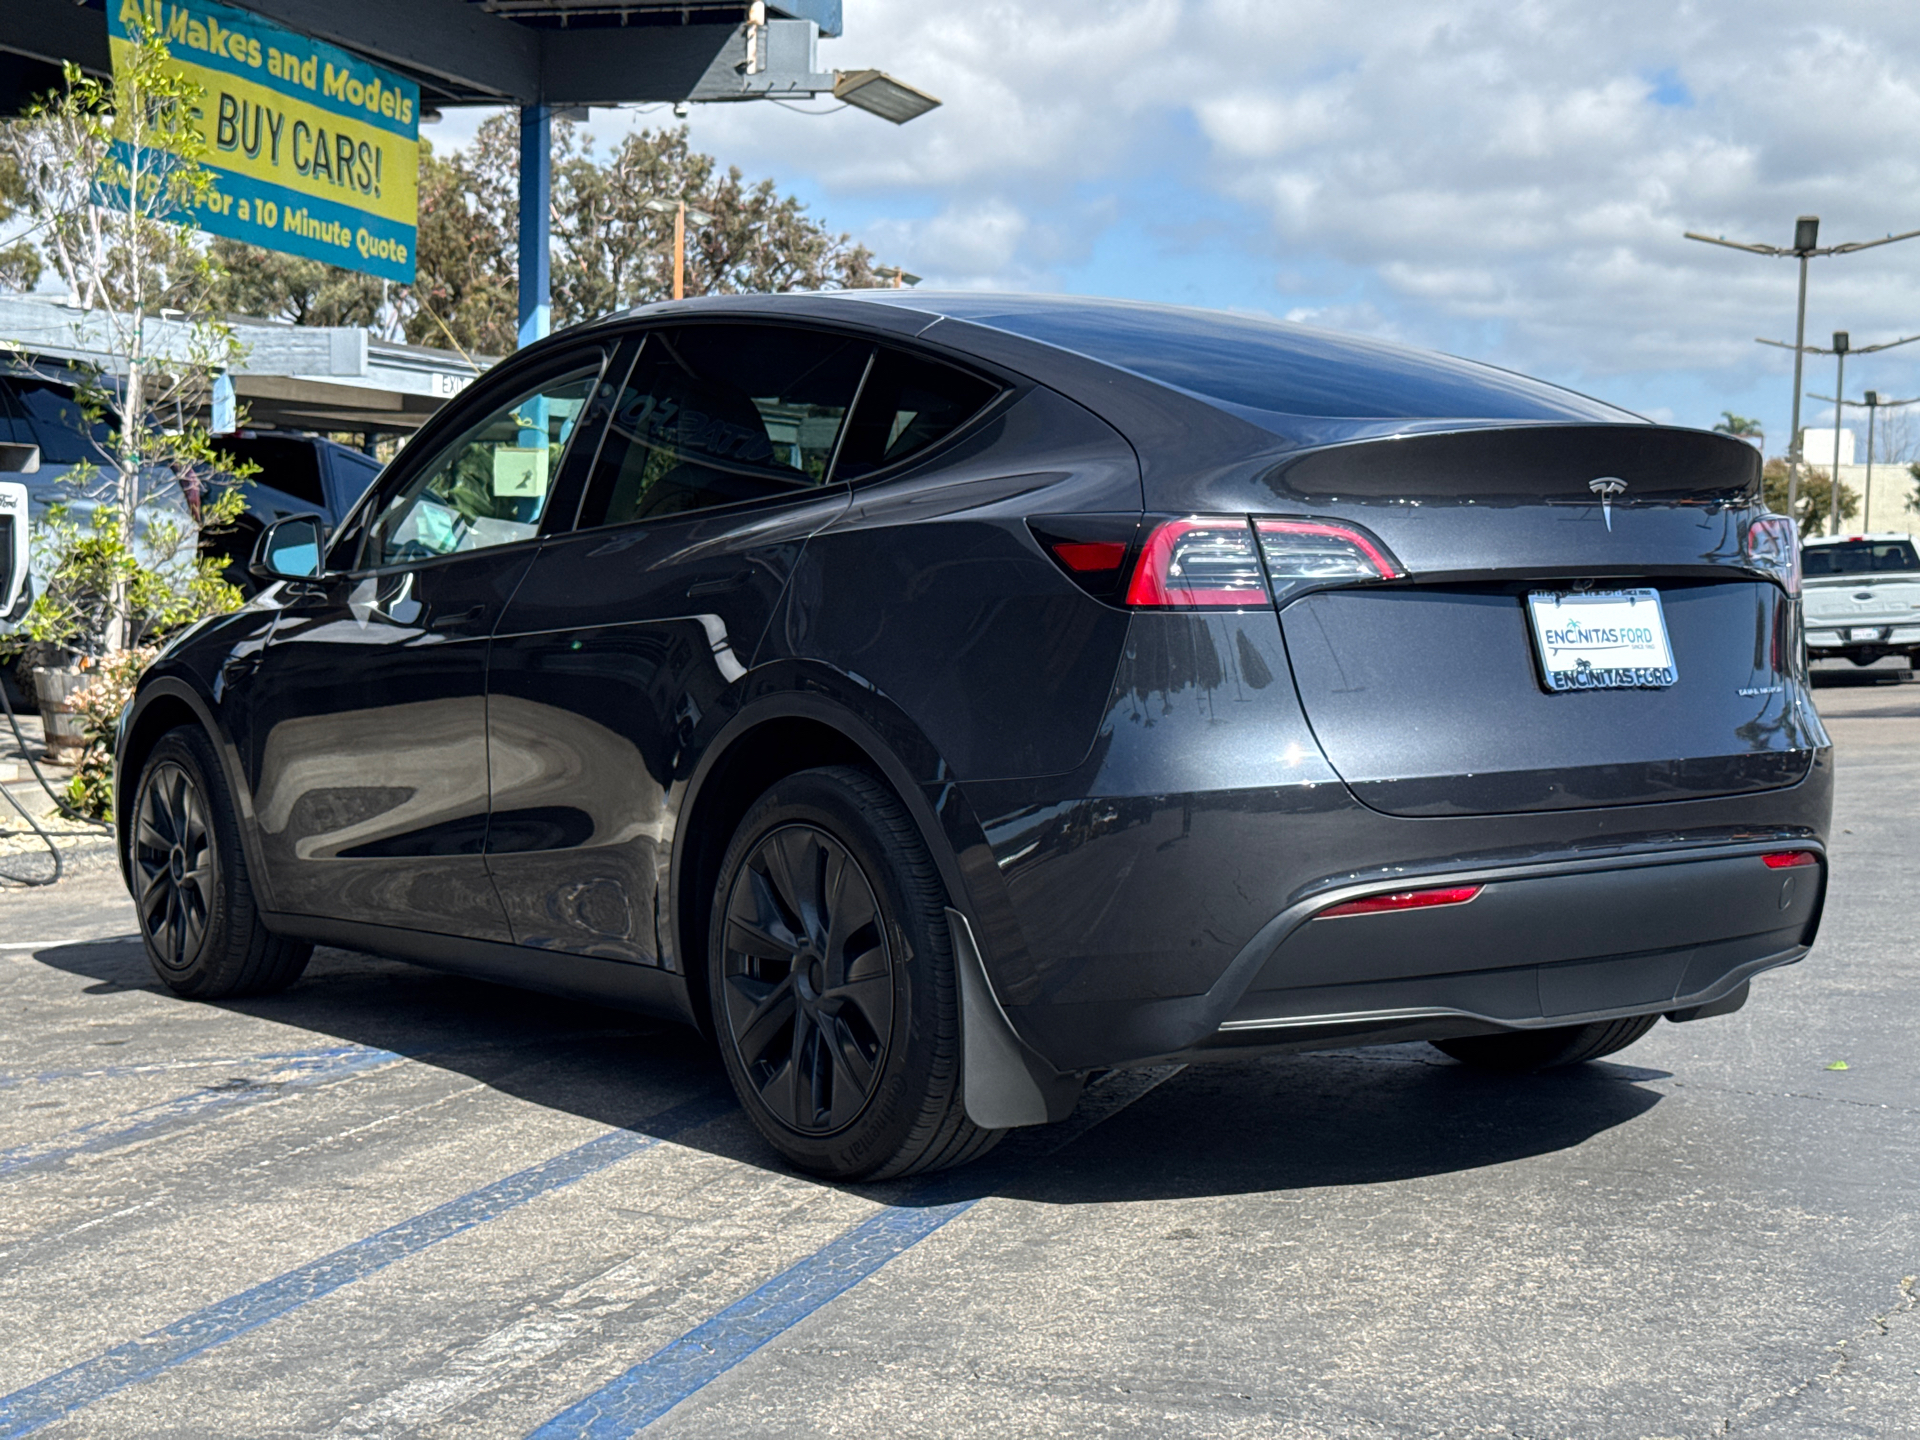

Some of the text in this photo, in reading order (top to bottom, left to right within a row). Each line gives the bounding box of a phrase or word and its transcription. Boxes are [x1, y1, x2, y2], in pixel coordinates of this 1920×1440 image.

[119, 0, 413, 125] All Makes and Models
[217, 92, 285, 166] BUY
[292, 120, 383, 198] CARS!
[237, 199, 250, 221] a
[255, 199, 278, 229] 10
[284, 207, 352, 249] Minute
[356, 228, 408, 264] Quote
[442, 374, 465, 395] EXIT
[1545, 627, 1653, 645] ENCINITAS FORD
[1553, 667, 1673, 688] ENCINITAS FORD
